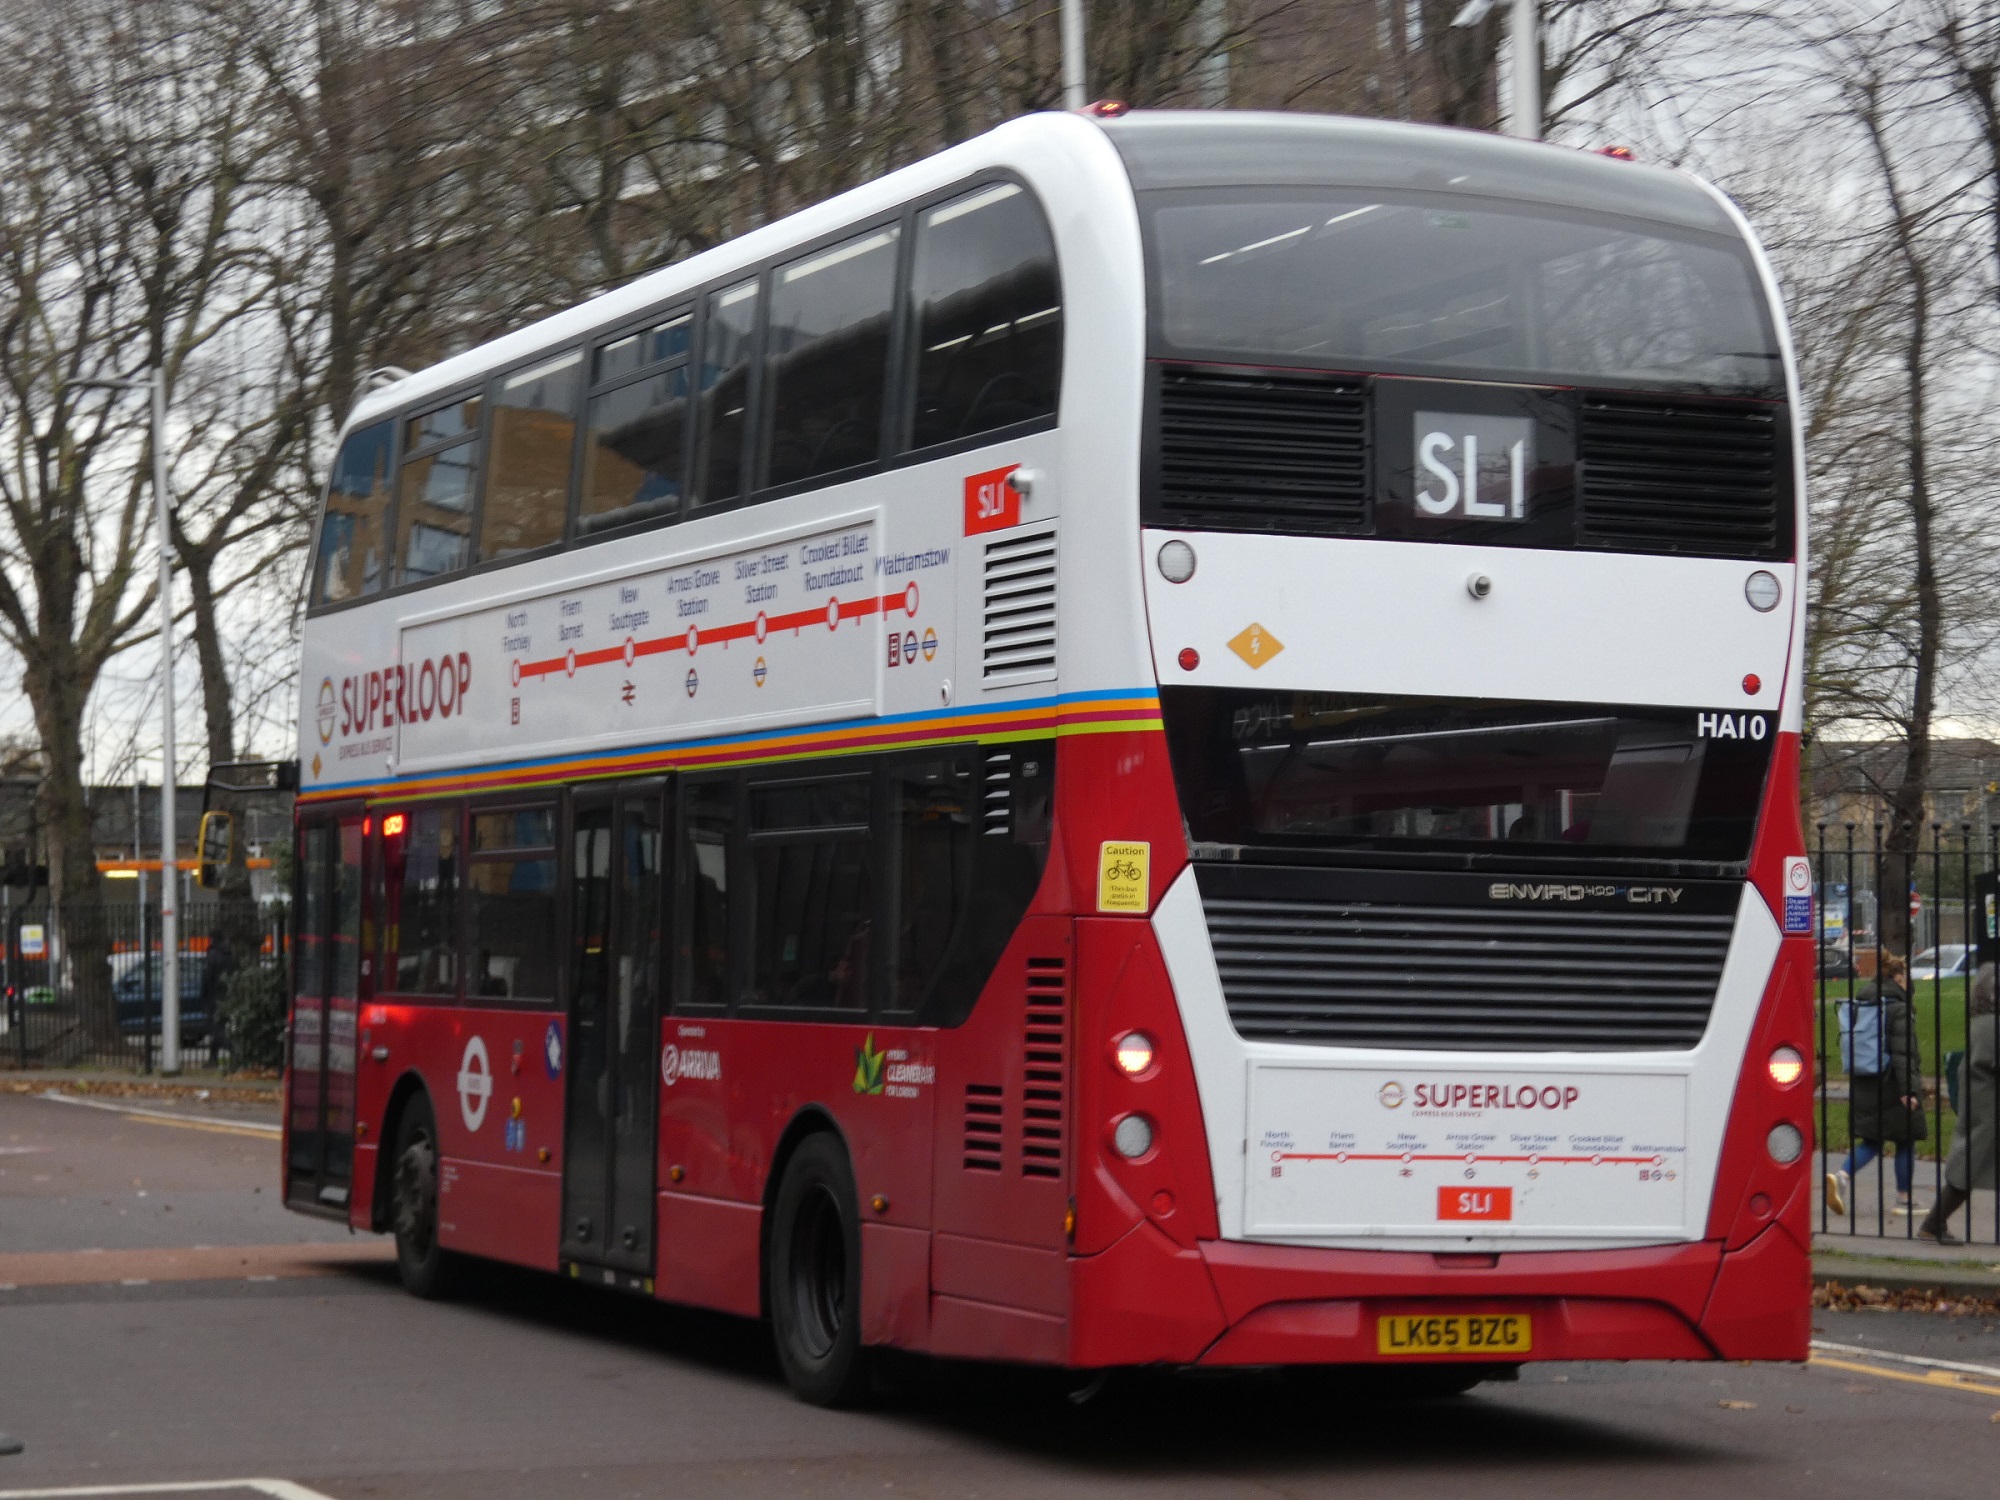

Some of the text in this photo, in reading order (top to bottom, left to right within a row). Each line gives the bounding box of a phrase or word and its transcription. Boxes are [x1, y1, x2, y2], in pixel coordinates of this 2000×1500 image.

[1416, 431, 1525, 518] SL1
[802, 533, 869, 565] Crooked Billet
[734, 552, 789, 580] Silver Street
[874, 548, 951, 577] Walthamstow
[666, 568, 720, 595] Arnos Grove
[805, 563, 864, 592] Roundabout
[619, 586, 640, 605] New
[745, 582, 778, 604] Station
[677, 597, 709, 617] Station
[507, 609, 528, 629] North
[609, 609, 650, 632] Southgate
[341, 651, 472, 737] SUPERLOOP
[1698, 712, 1766, 740] HA10
[1106, 846, 1145, 855] Caution
[1413, 1083, 1580, 1110] SUPERLOOP
[1260, 1140, 1294, 1149] Finchley
[1265, 1131, 1290, 1139] North
[1329, 1141, 1356, 1149] Barnet
[1386, 1141, 1427, 1151] Southgate
[1456, 1142, 1484, 1150] Station
[1520, 1143, 1548, 1151] Station
[1458, 1192, 1492, 1213] SL1
[1389, 1318, 1519, 1347] LK65 BZG
